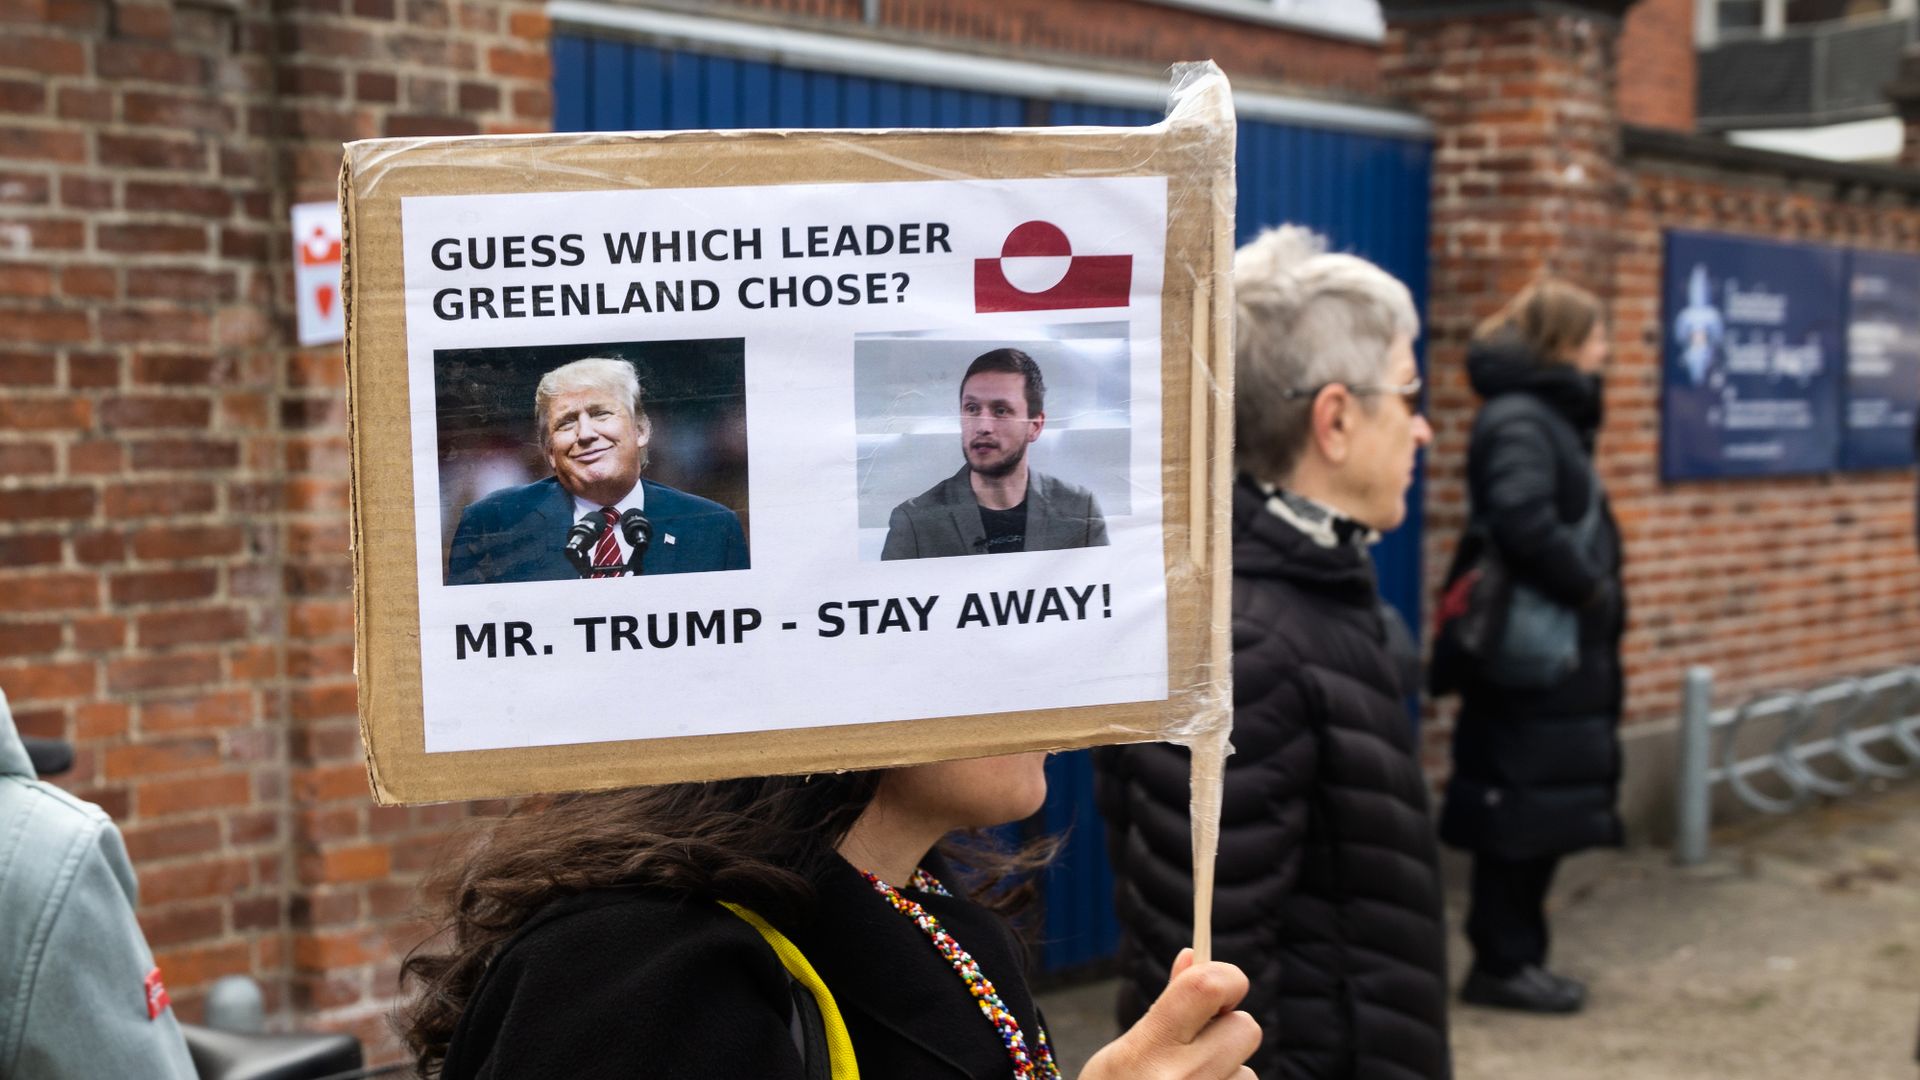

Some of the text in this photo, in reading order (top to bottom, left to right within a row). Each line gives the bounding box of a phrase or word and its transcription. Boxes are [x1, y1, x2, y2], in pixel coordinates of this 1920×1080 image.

[431, 222, 952, 271] GUESS WHICH LEADER
[432, 271, 912, 321] GREENLAND CHOSE?
[455, 583, 1112, 660] MR. TRUMP - STAY AWAY!
